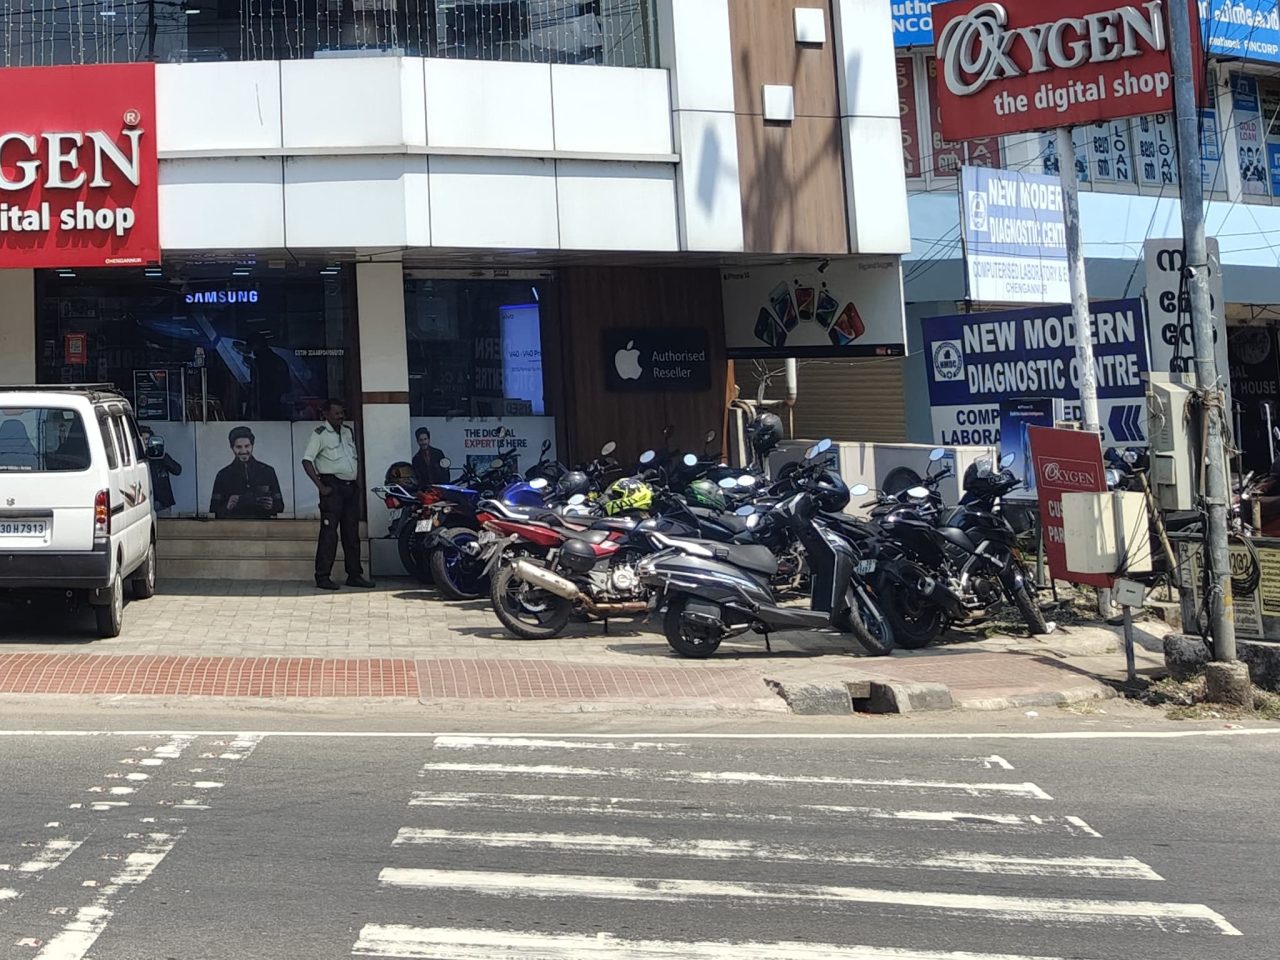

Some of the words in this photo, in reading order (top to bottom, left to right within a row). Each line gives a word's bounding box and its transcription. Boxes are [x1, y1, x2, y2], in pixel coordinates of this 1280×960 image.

[936, 0, 1167, 97] OXYGEN
[993, 85, 1029, 116] the
[1034, 78, 1107, 113] digital
[1113, 70, 1170, 100] shop
[1113, 125, 1129, 180] LOAN
[988, 178, 1017, 208] NEW
[1019, 181, 1064, 212] MODER
[59, 200, 136, 237] shop
[989, 216, 1042, 247] DIAGNOSTIC
[184, 289, 260, 305] SAMSUNG
[1005, 281, 1048, 295] CHENGANNUR
[962, 320, 1017, 354] NEW
[651, 349, 706, 362] Authorised
[653, 366, 692, 379] Reseller
[966, 359, 1066, 394] DIAGNOSTIC
[1071, 353, 1141, 390] CNTRE
[464, 428, 481, 438] THE
[464, 438, 496, 449] EXPERT
[506, 438, 528, 448] HERE
[1042, 462, 1095, 485] OXYGEN
